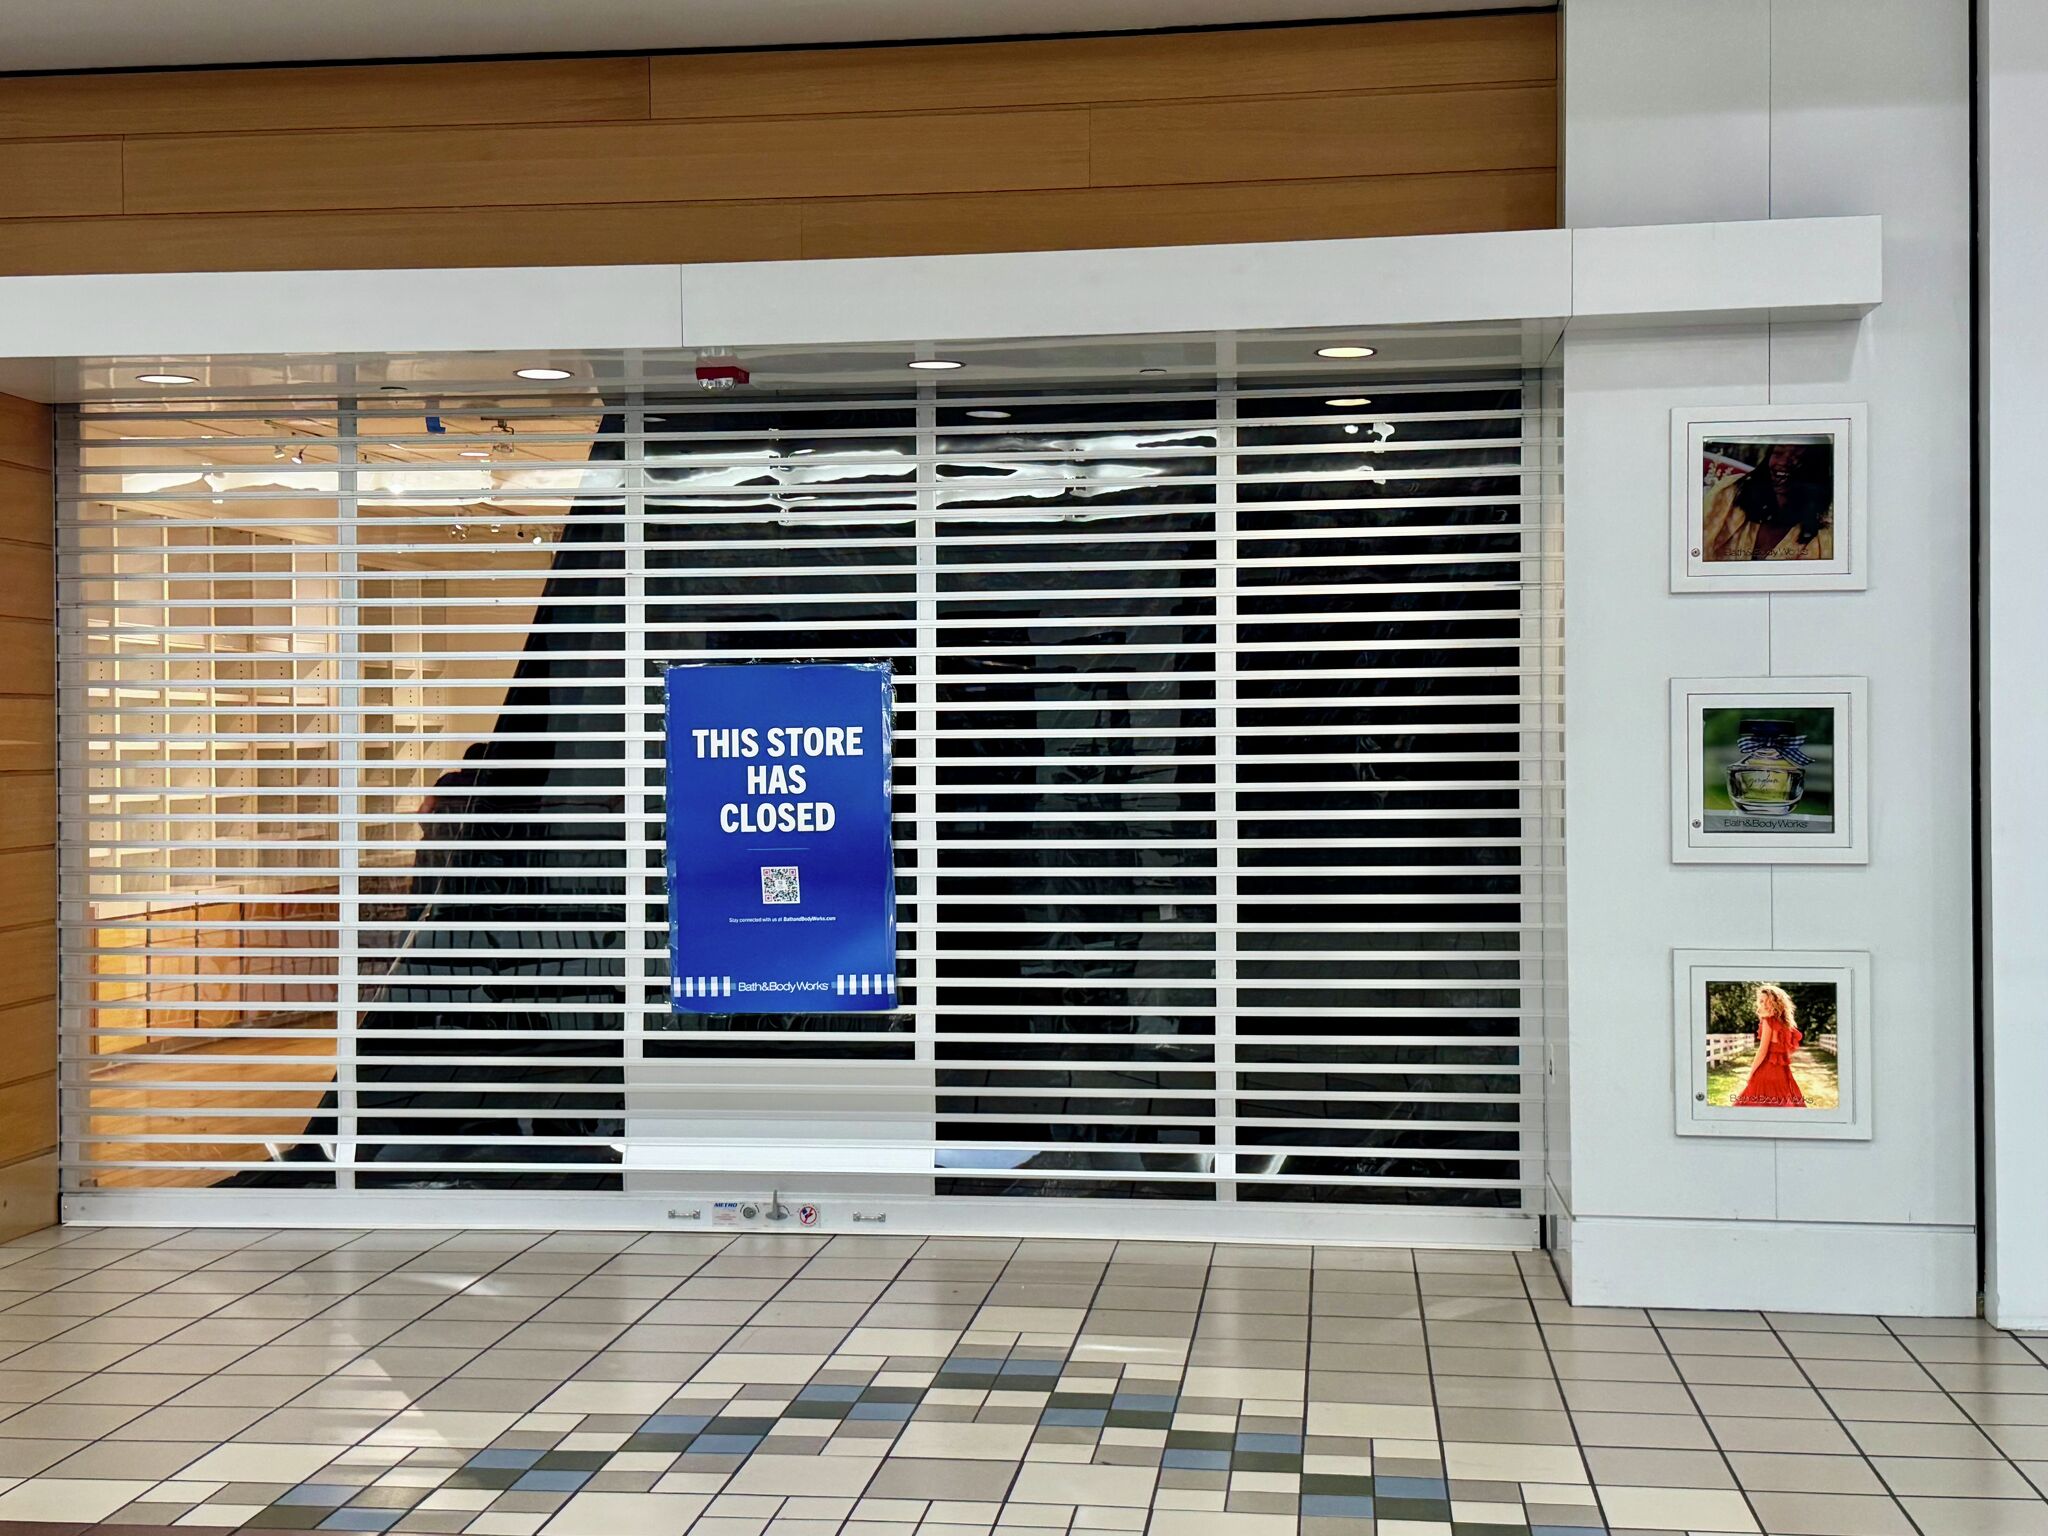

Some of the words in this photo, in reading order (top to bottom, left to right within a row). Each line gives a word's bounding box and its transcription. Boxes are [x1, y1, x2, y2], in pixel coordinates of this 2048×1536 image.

[692, 728, 759, 758] THIS
[767, 726, 863, 757] STORE
[747, 764, 807, 795] HAS
[720, 802, 836, 833] CLOSED
[1724, 818, 1778, 829] Bath&Body
[1778, 819, 1809, 828] Works
[738, 981, 796, 993] Bath&Body
[796, 981, 829, 991] Works
